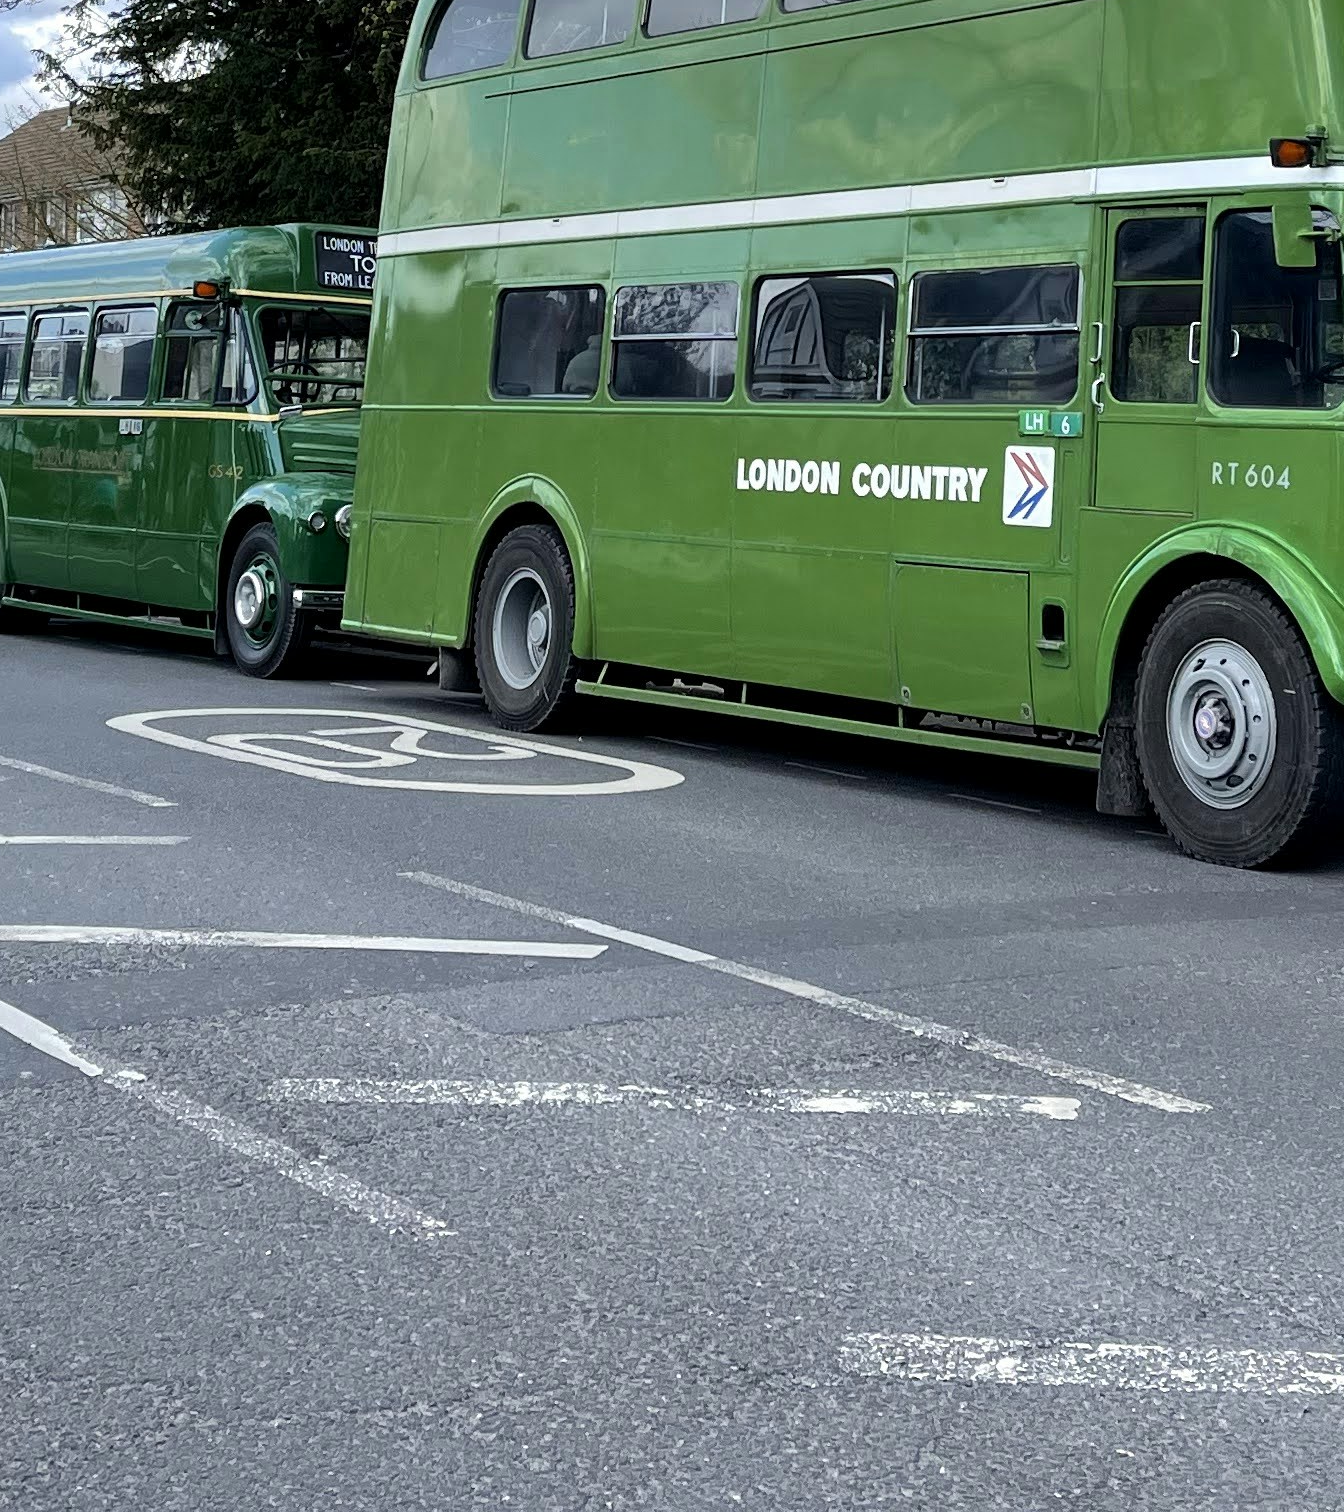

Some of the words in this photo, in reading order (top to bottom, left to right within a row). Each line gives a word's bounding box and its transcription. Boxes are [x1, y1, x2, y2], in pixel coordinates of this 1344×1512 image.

[323, 236, 364, 254] LONDON
[324, 271, 353, 287] FROM
[1025, 412, 1044, 431] LH
[1061, 415, 1071, 435] 6
[736, 457, 841, 496] LONDON
[851, 461, 989, 503] COUNTRY
